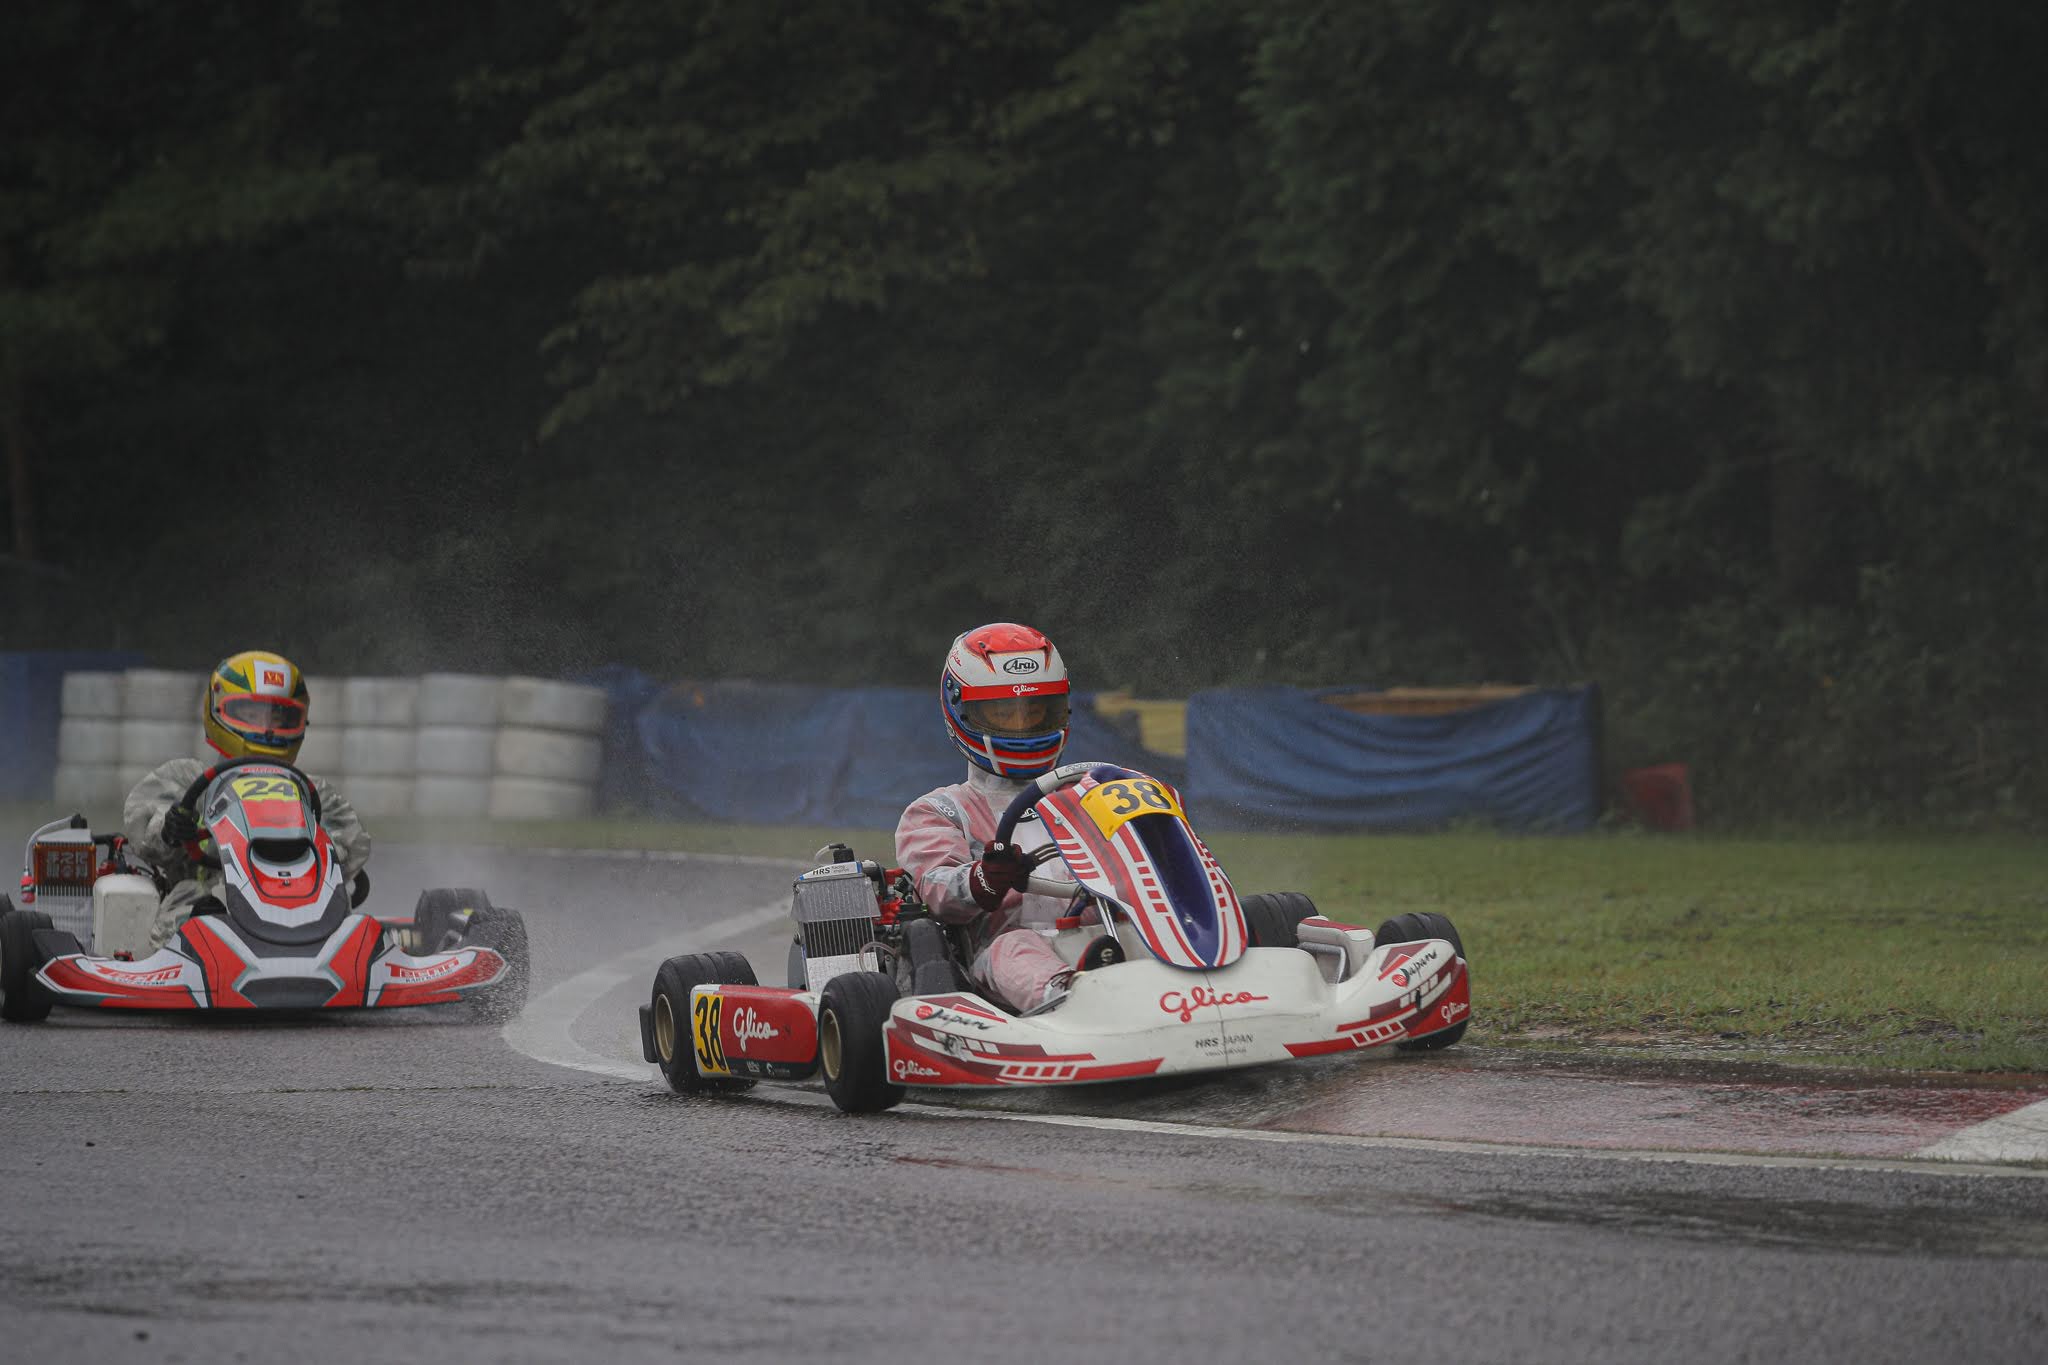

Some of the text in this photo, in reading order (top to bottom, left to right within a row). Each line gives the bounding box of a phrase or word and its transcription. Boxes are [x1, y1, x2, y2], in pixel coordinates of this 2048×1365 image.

[1006, 660, 1036, 672] Arai
[1012, 685, 1039, 696] Glico
[241, 781, 298, 798] 24
[1102, 781, 1172, 815] 38
[813, 867, 831, 876] HRS
[1159, 985, 1270, 1024] Glico
[695, 995, 727, 1072] 38
[732, 1006, 779, 1053] Glico
[1195, 1034, 1253, 1048] HRS JAPAN
[893, 1059, 942, 1080] Glico
